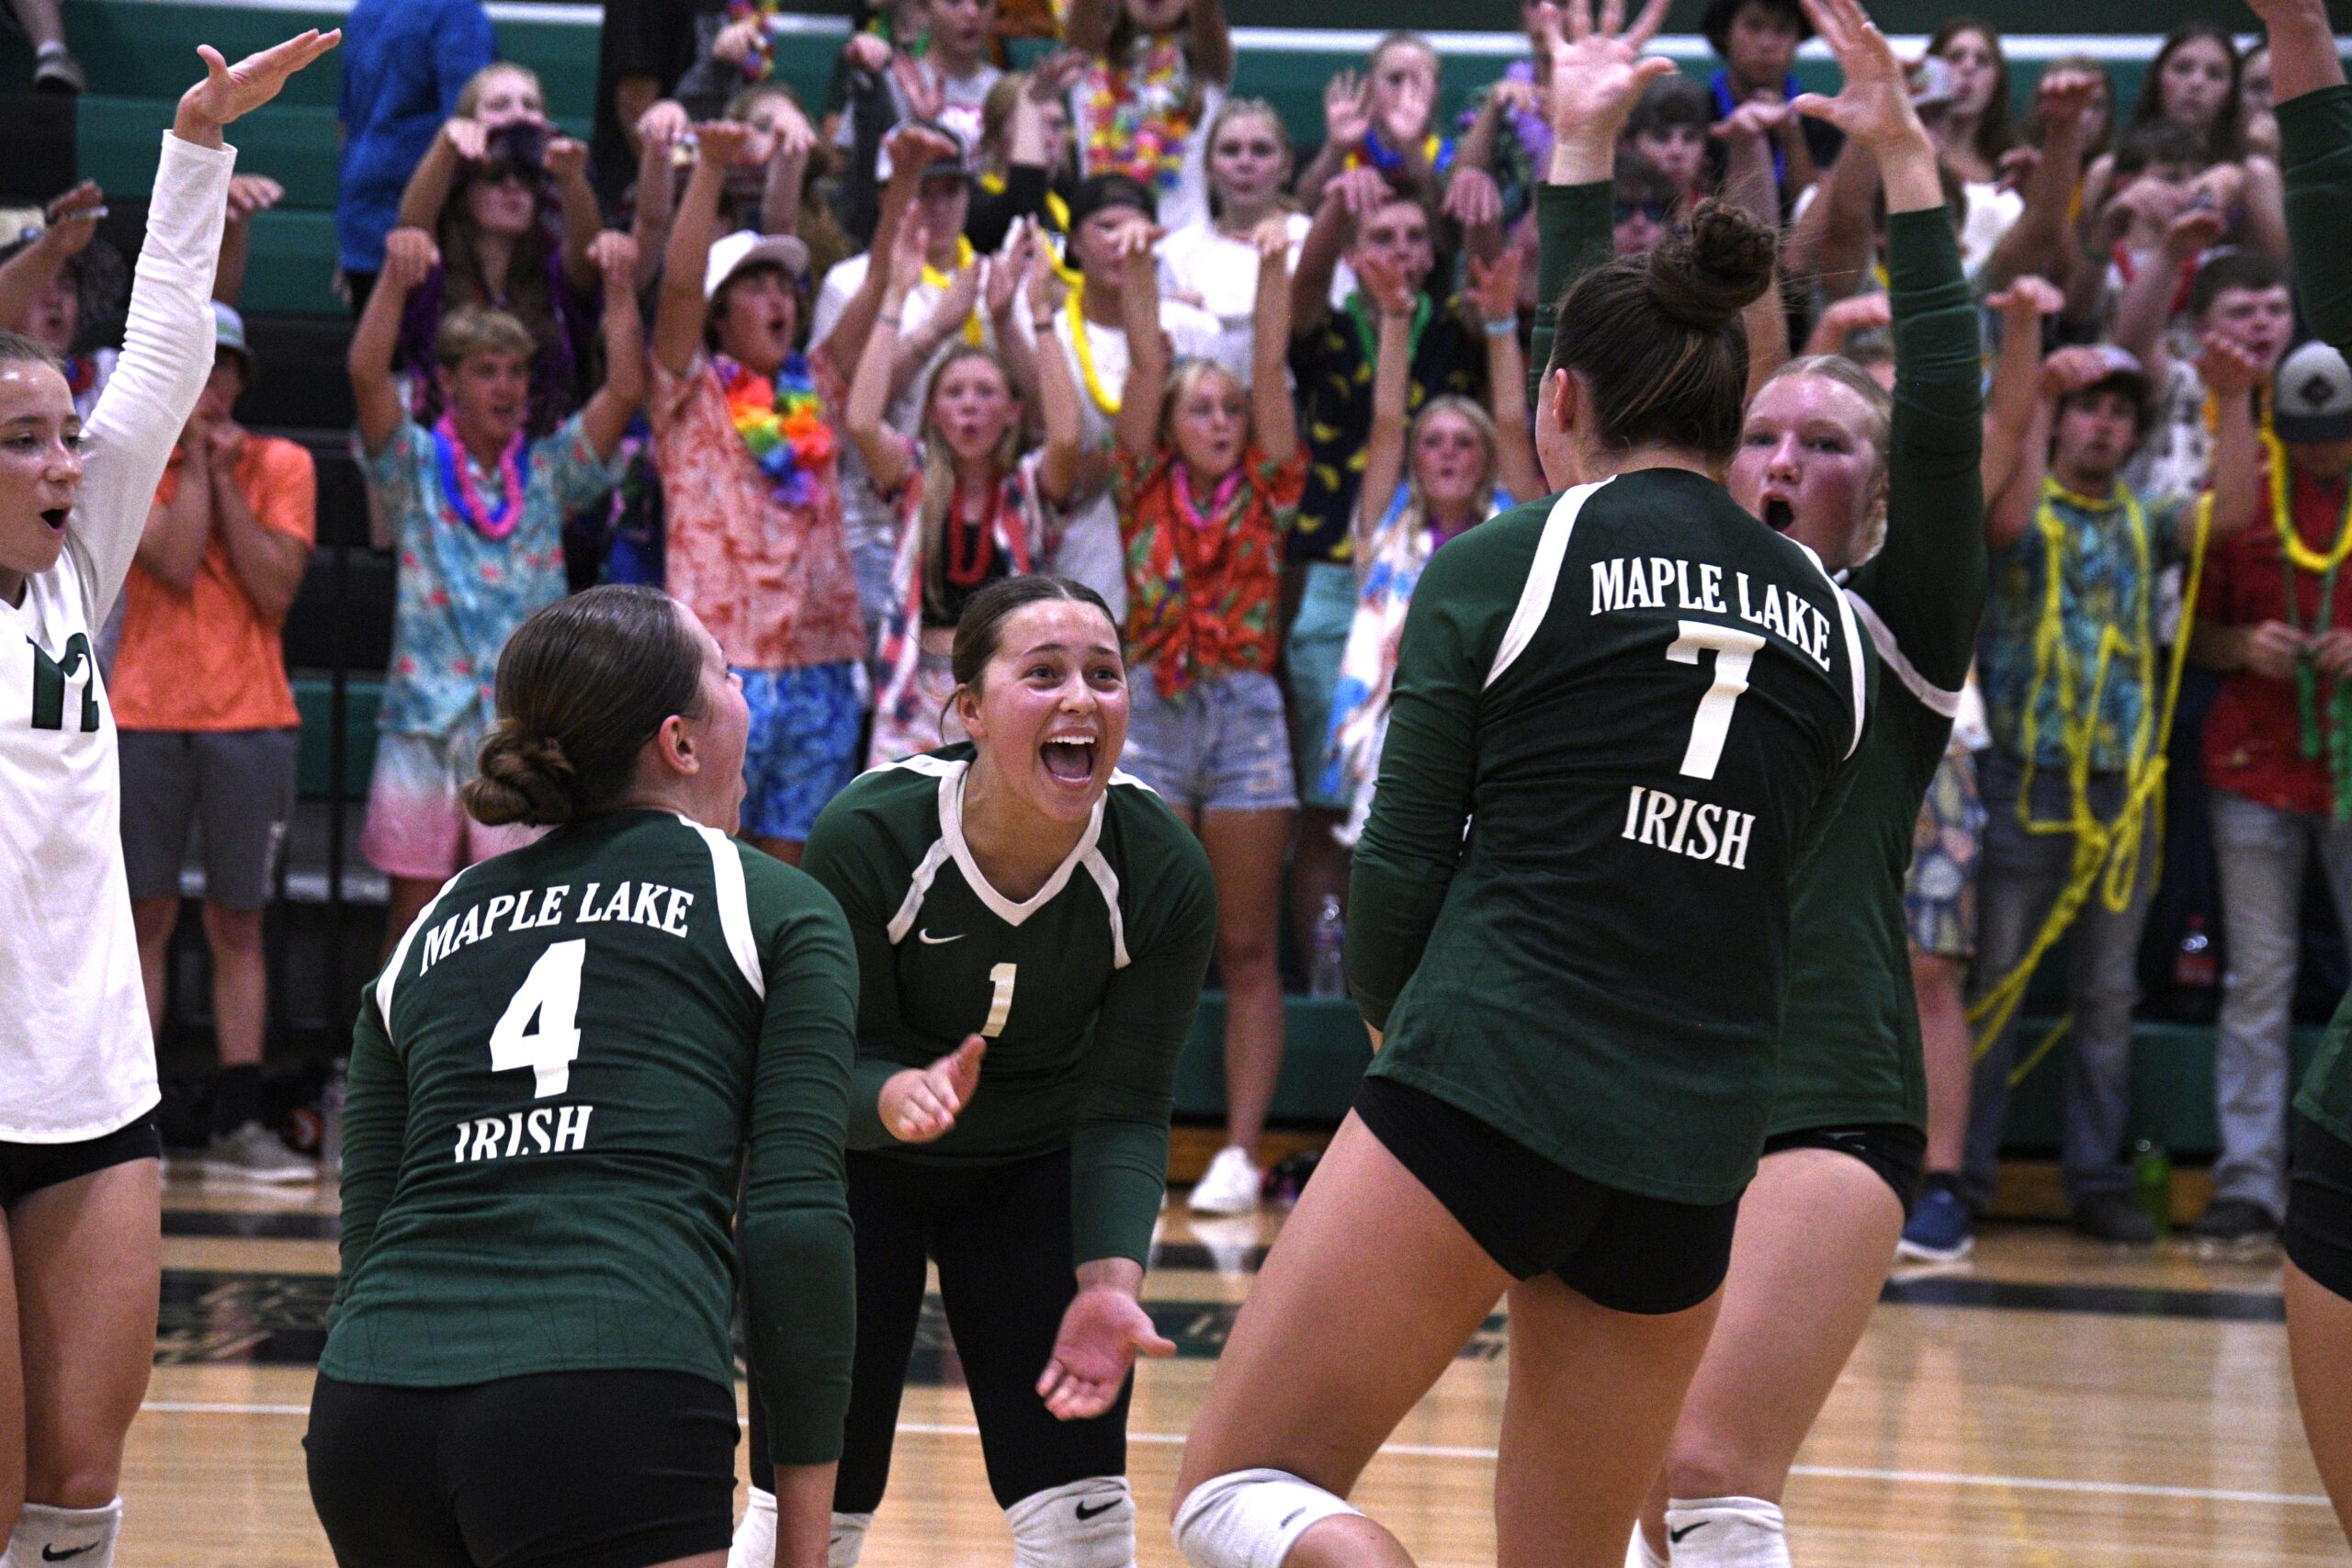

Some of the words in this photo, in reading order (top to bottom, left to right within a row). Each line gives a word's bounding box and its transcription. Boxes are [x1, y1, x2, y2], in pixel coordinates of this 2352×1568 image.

[1590, 556, 1727, 615] MAPLE
[1736, 571, 1831, 672] LAKE
[1666, 619, 1767, 781] 7
[1621, 785, 1757, 870] IRISH
[419, 884, 571, 977] MAPLE
[575, 881, 695, 939] LAKE
[489, 937, 586, 1100] 4
[979, 962, 1017, 1038] 1
[454, 1105, 594, 1164] IRISH
